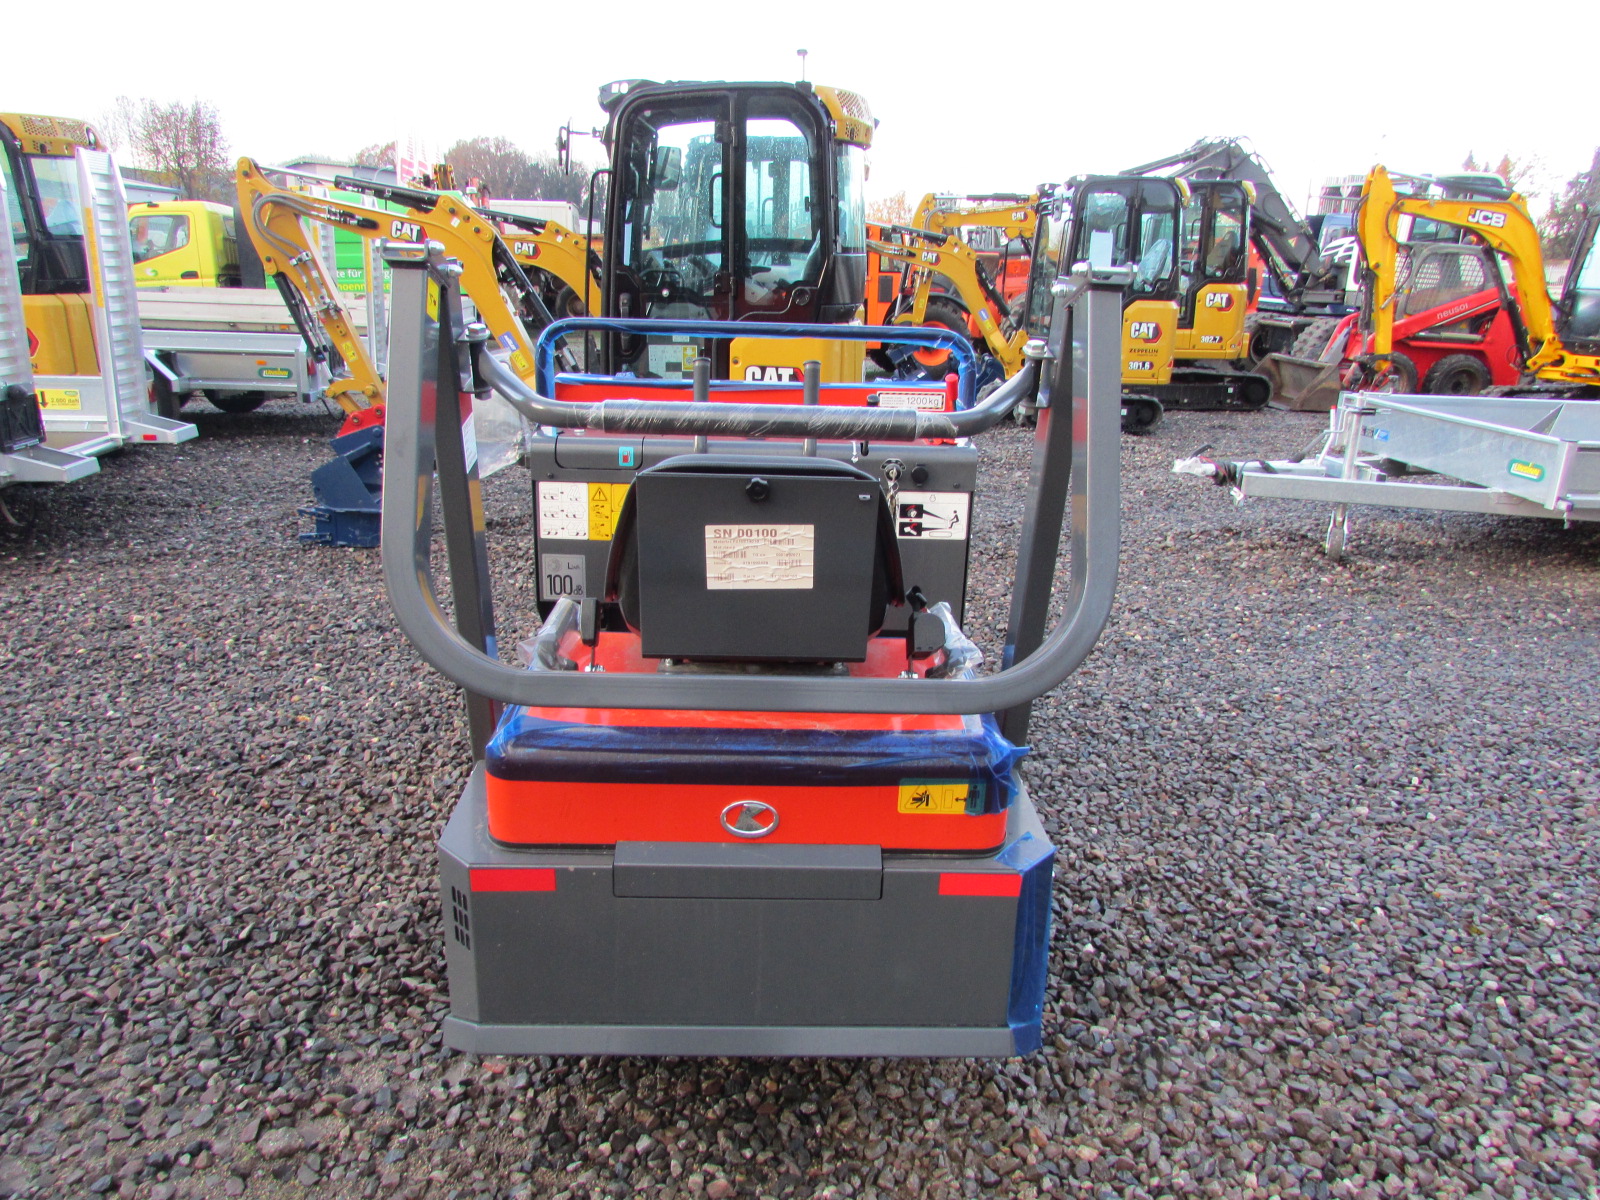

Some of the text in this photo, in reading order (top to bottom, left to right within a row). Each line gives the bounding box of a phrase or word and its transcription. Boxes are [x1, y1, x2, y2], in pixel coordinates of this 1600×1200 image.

[1012, 211, 1025, 220] CAT
[1468, 209, 1505, 227] JCB
[391, 220, 420, 242] CAT
[514, 241, 535, 256] CAT
[921, 251, 938, 263] CAT
[1205, 293, 1229, 308] CAT
[1130, 321, 1156, 339] CAT
[1200, 335, 1220, 343] 302.7
[1128, 361, 1151, 370] 301.6
[745, 365, 794, 382] CAT
[713, 528, 733, 538] SN
[546, 574, 573, 596] 100
